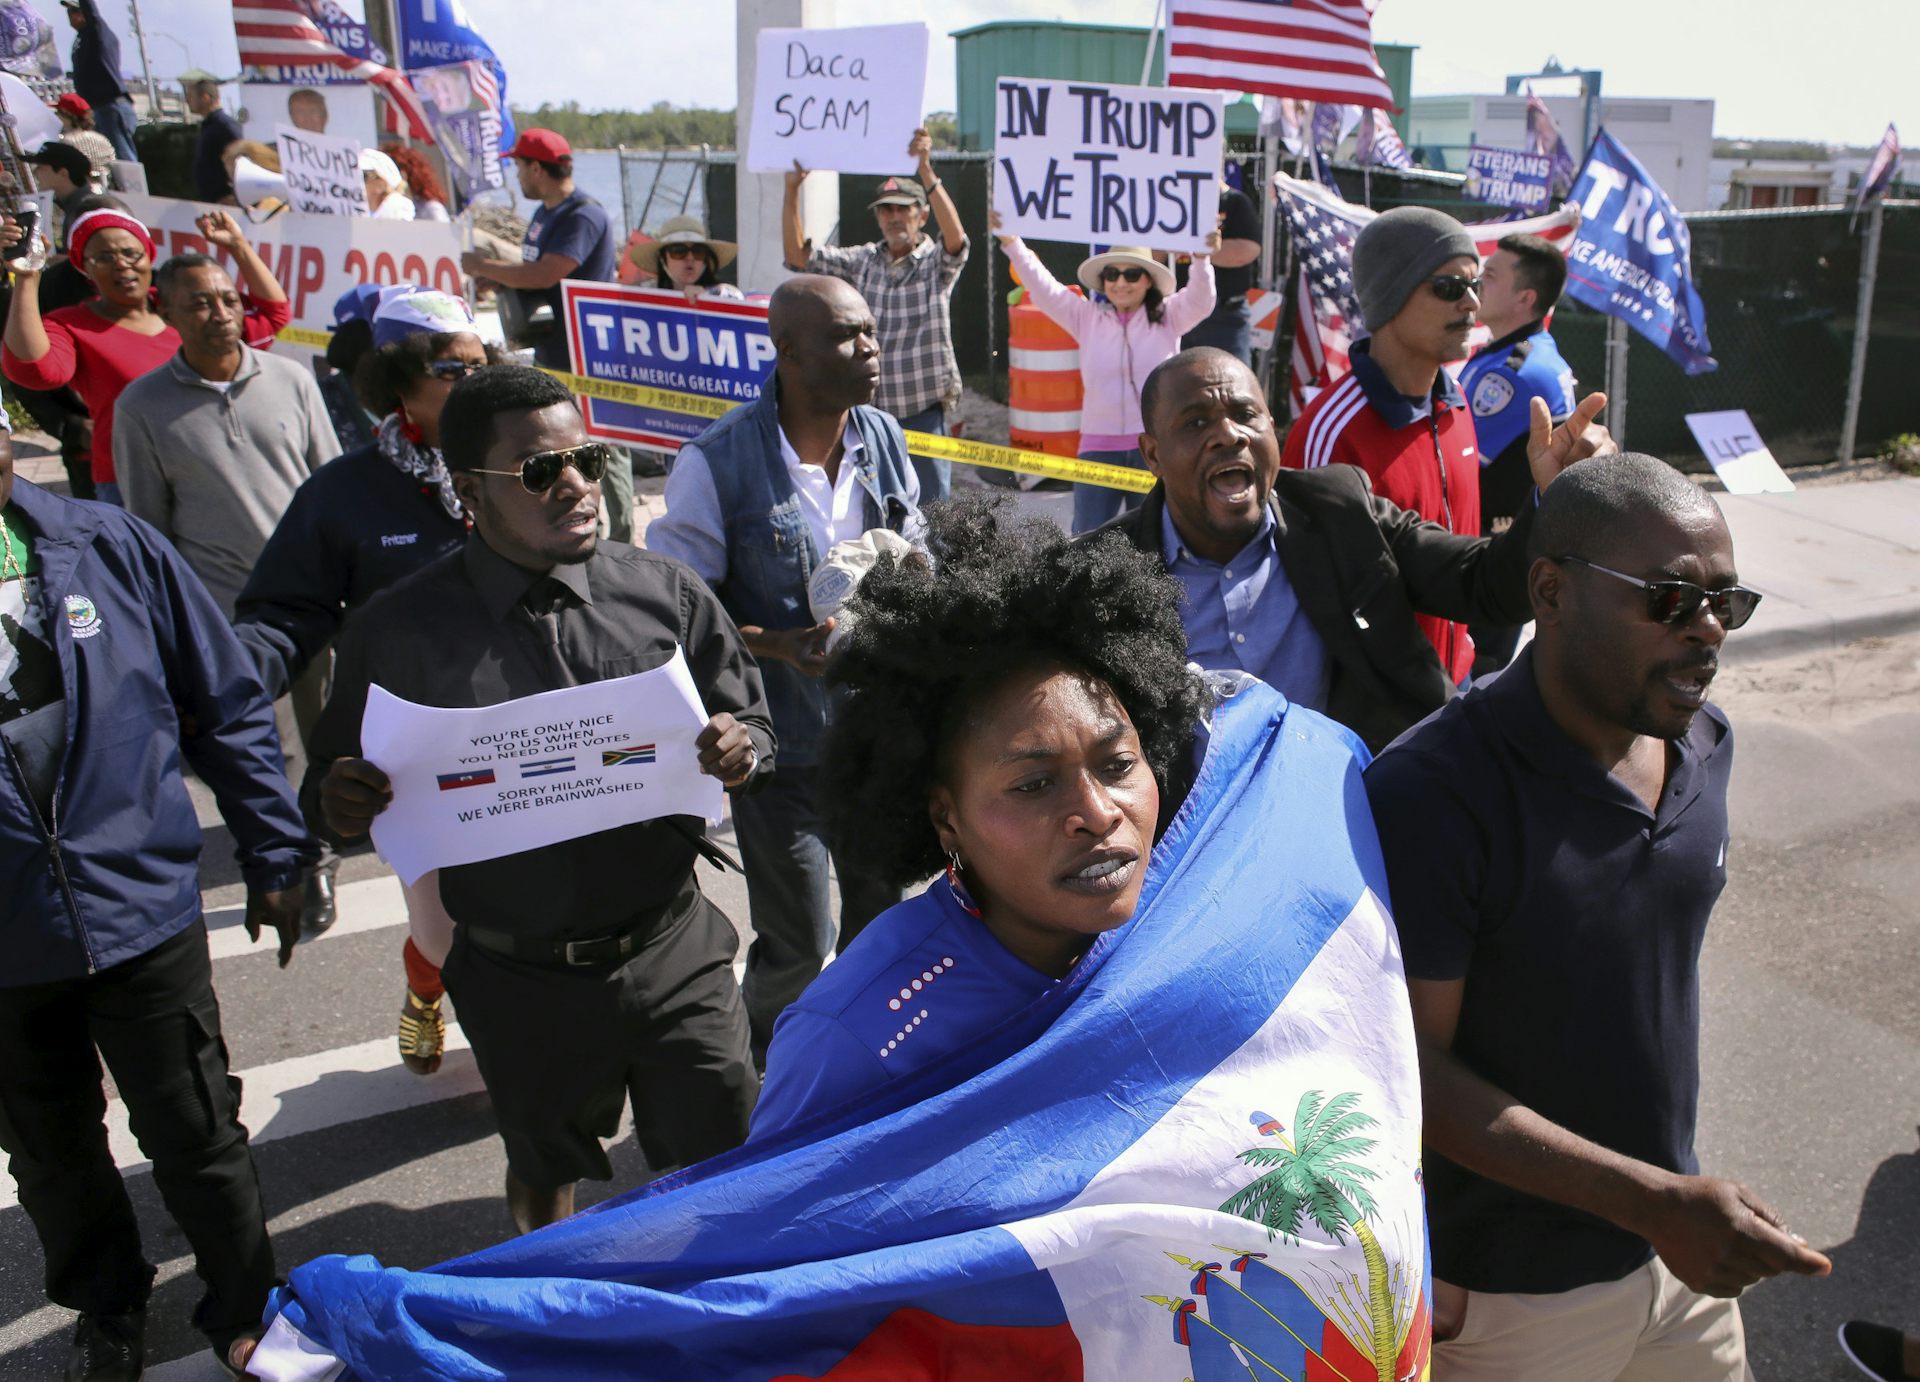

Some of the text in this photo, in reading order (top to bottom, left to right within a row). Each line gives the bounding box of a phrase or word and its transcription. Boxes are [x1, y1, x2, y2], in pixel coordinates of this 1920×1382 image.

[786, 41, 870, 80] Daca
[775, 93, 870, 137] SCAM
[999, 83, 1216, 157] IN TRUMP
[280, 132, 359, 178] TRUMP
[1471, 149, 1551, 178] ETERANS
[999, 152, 1213, 237] WE TRUST
[1481, 177, 1547, 206] TRUMP
[1582, 158, 1675, 256] TRU
[585, 313, 777, 372] TRUMP
[592, 361, 761, 399] MAKE AMERICA GREAT AGA
[458, 733, 631, 765] YOU NEED OUR VOTES
[470, 714, 615, 747] YOU'RE ONLY NICE
[494, 729, 594, 752] TO US WHEN
[457, 782, 645, 823] WE WERE BRAINWASHED
[497, 776, 604, 802] SORRY HILARY
